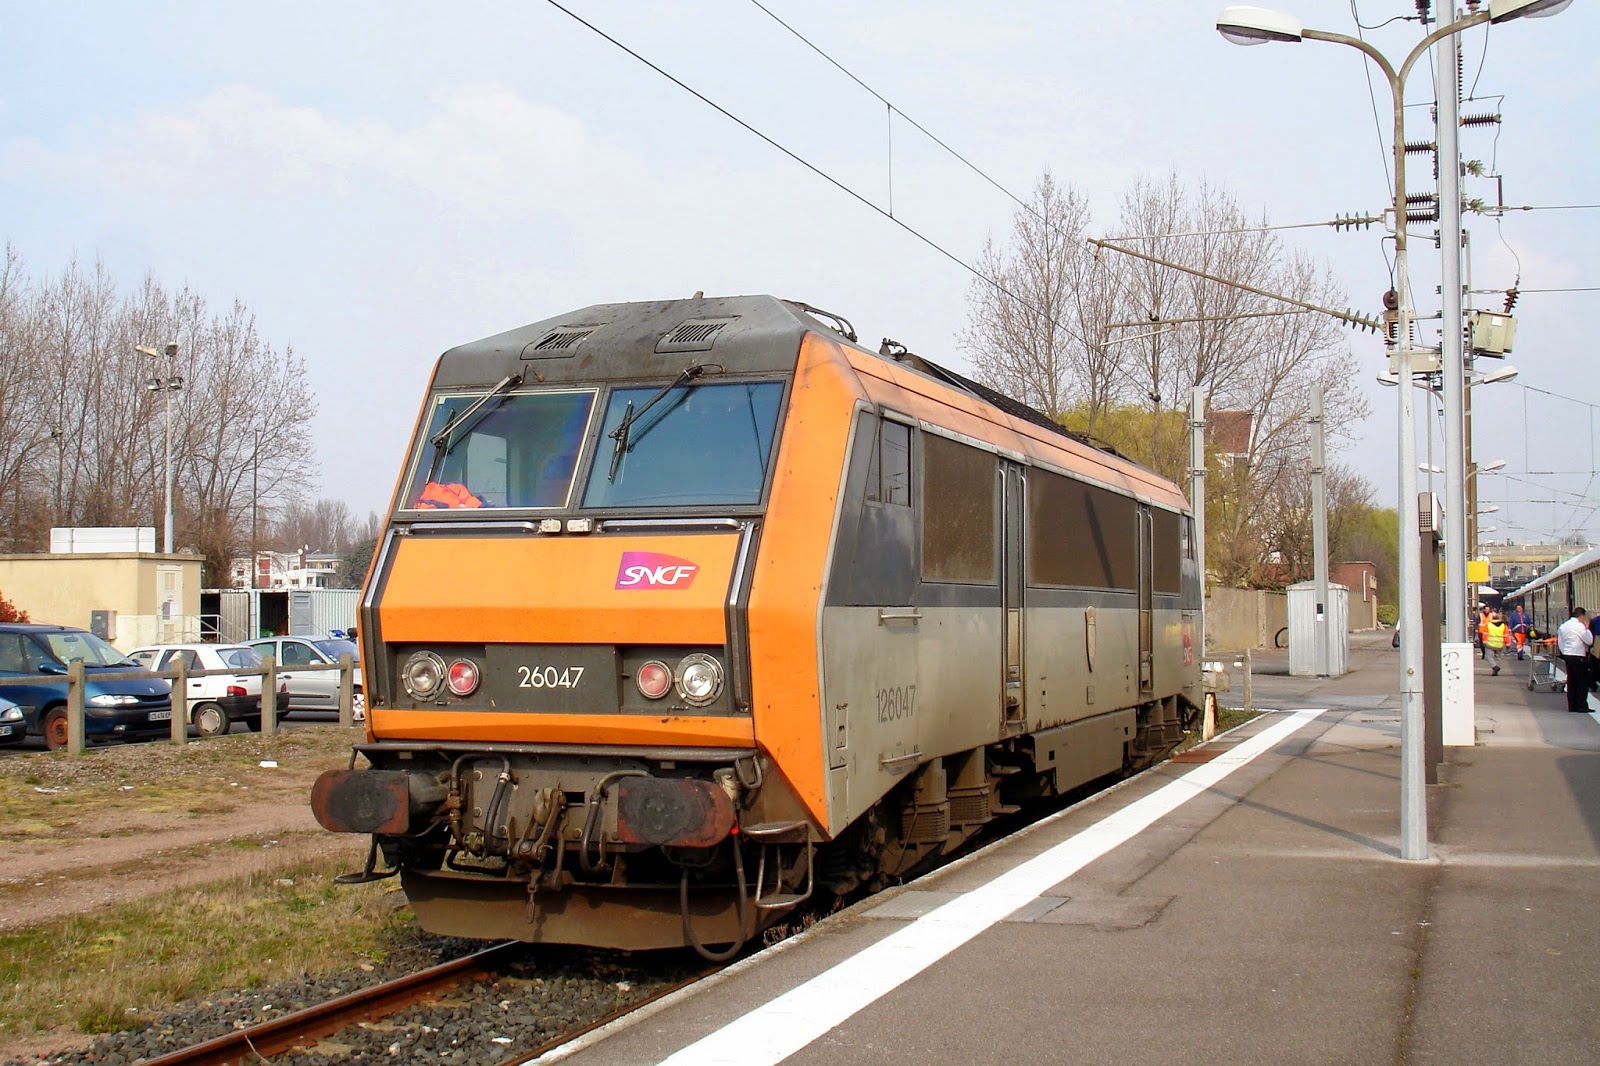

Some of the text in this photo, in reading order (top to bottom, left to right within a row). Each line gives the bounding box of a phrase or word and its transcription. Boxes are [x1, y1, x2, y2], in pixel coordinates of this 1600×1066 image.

[619, 565, 697, 585] SNCF
[517, 665, 586, 689] 26047
[876, 684, 917, 723] 126047
